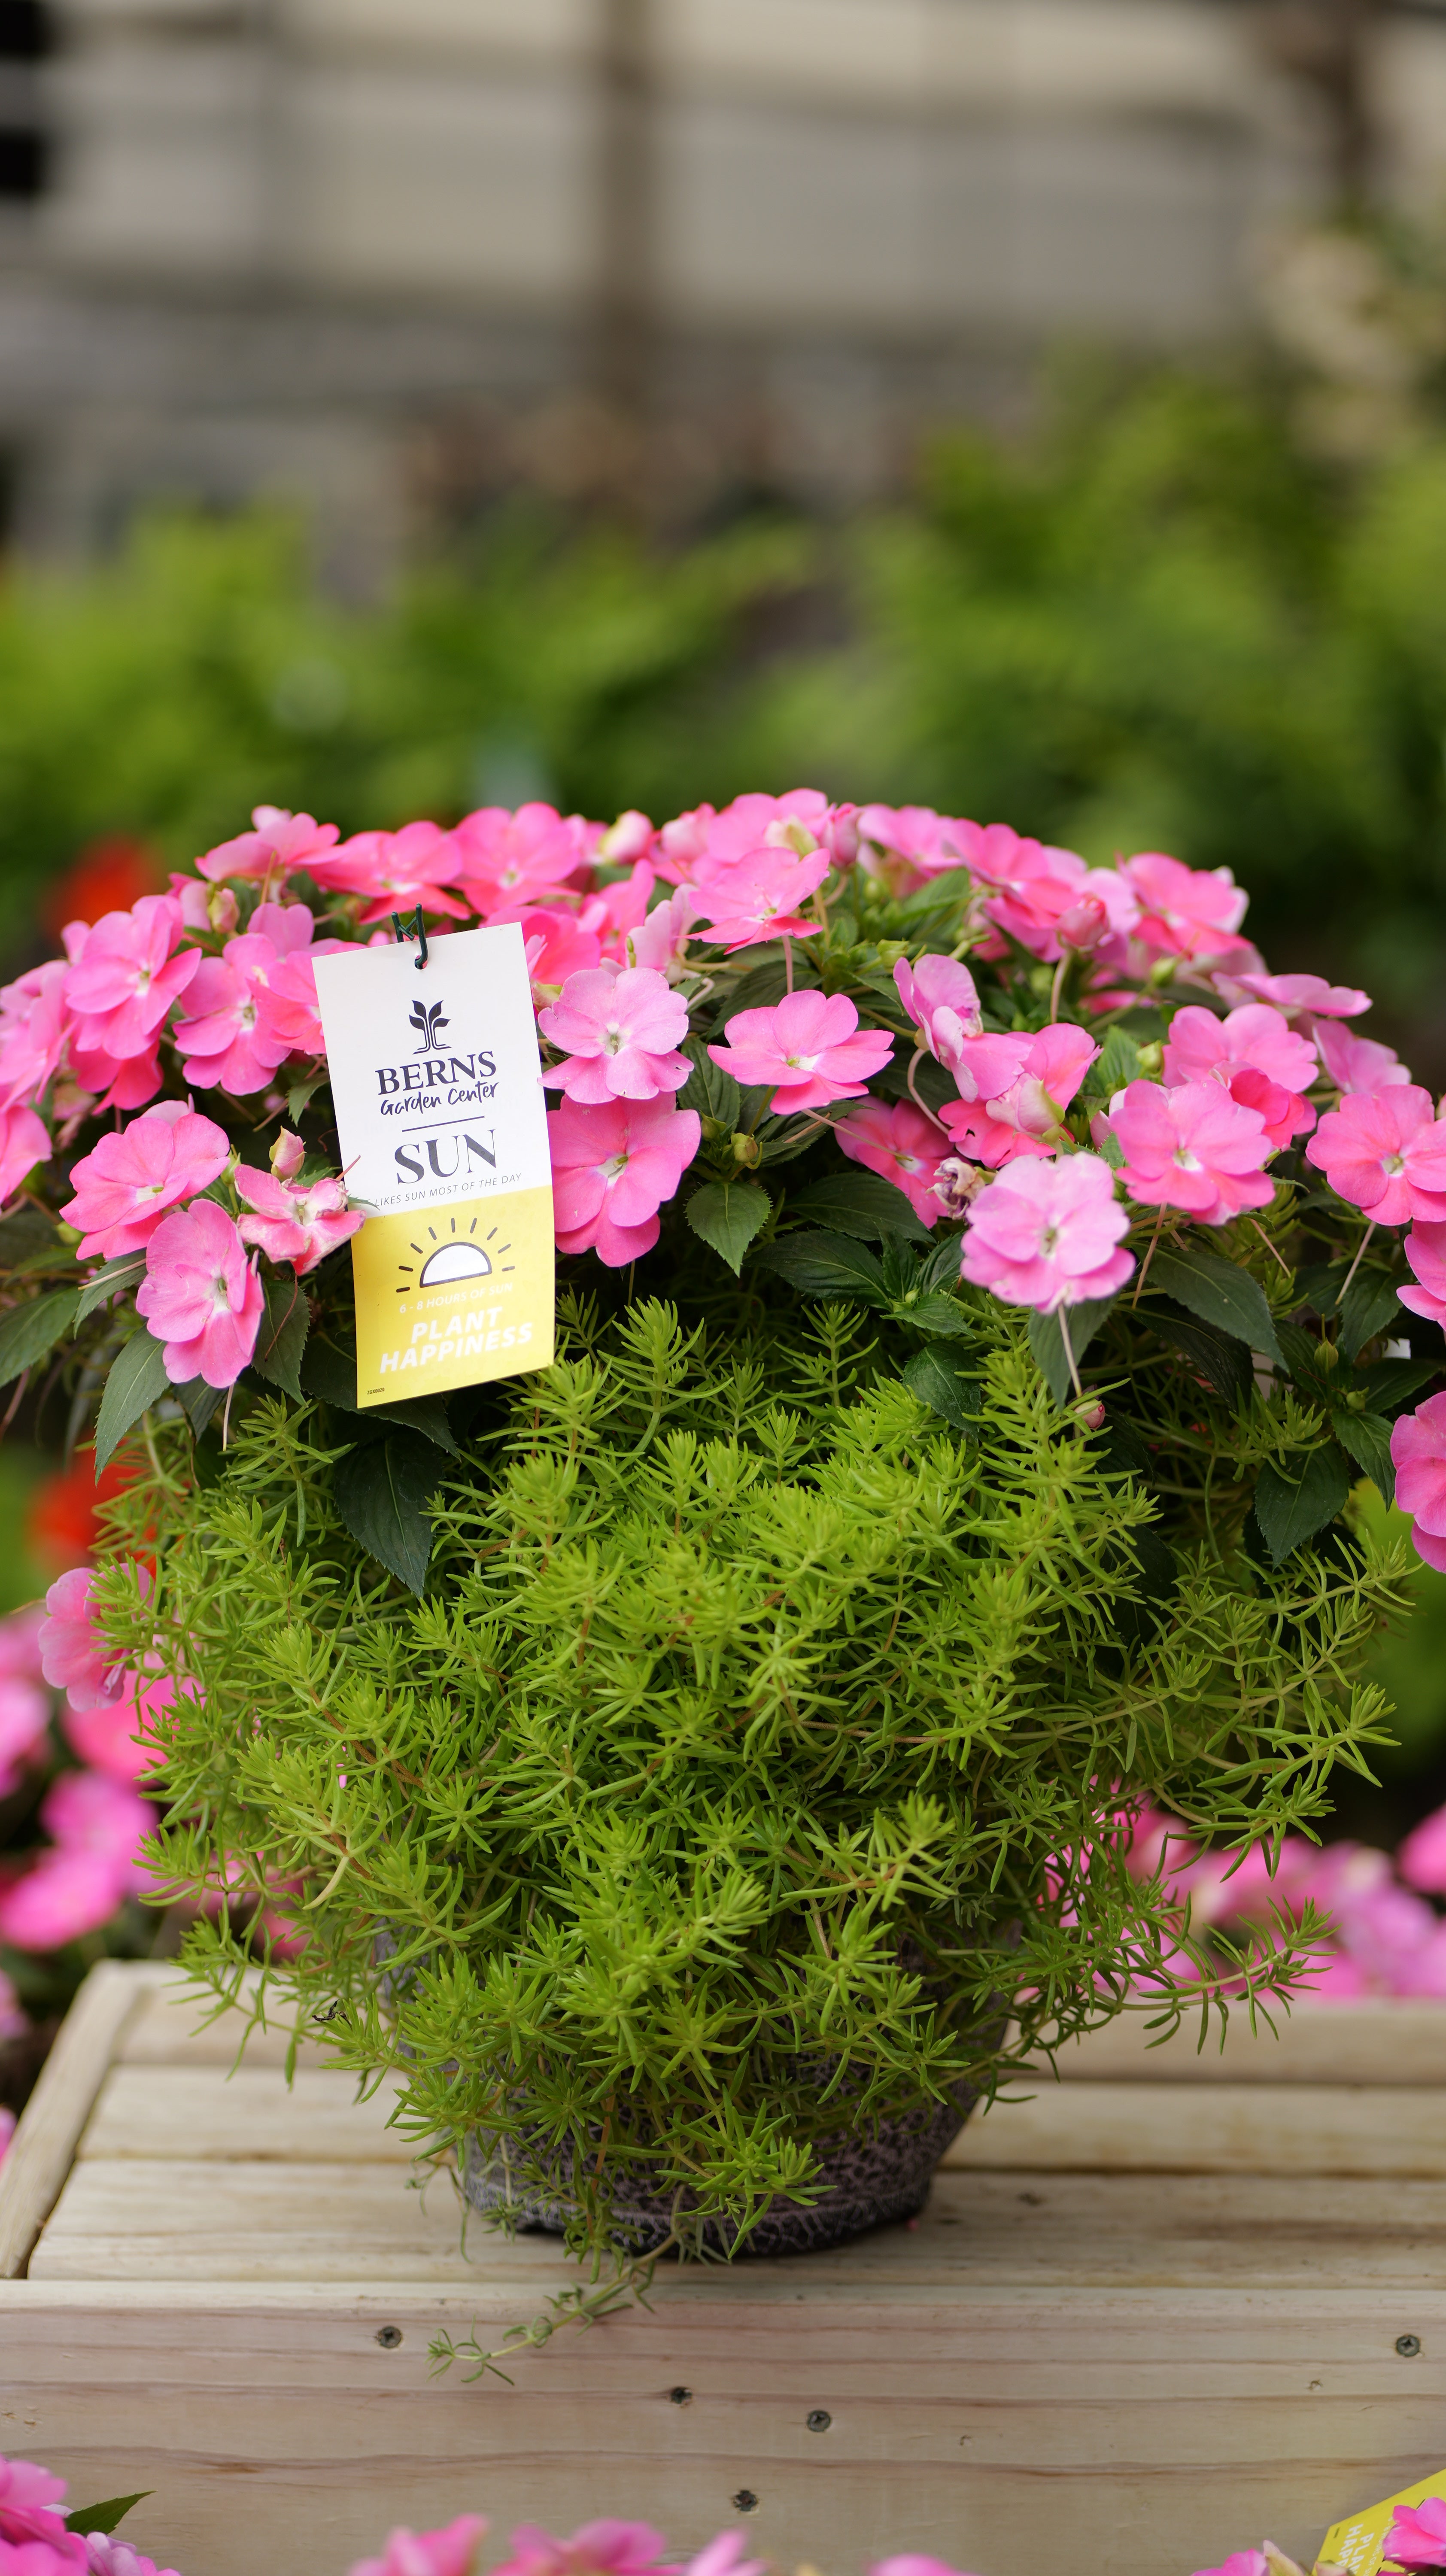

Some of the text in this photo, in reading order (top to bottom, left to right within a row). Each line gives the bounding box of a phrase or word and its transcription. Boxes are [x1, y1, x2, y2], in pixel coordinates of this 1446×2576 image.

[375, 1051, 496, 1095] BERNS
[380, 1081, 500, 1115] Garden Center
[394, 1128, 497, 1185] SUN
[375, 1173, 521, 1206] LIKES SUN MOST OF THE DAY
[399, 1304, 406, 1313] 6
[416, 1301, 423, 1310] 8
[426, 1291, 467, 1308] HOURS
[470, 1288, 486, 1299] OF
[489, 1282, 513, 1296] SUN
[411, 1306, 503, 1344] PLANT
[380, 1322, 533, 1374] HAPPINESS
